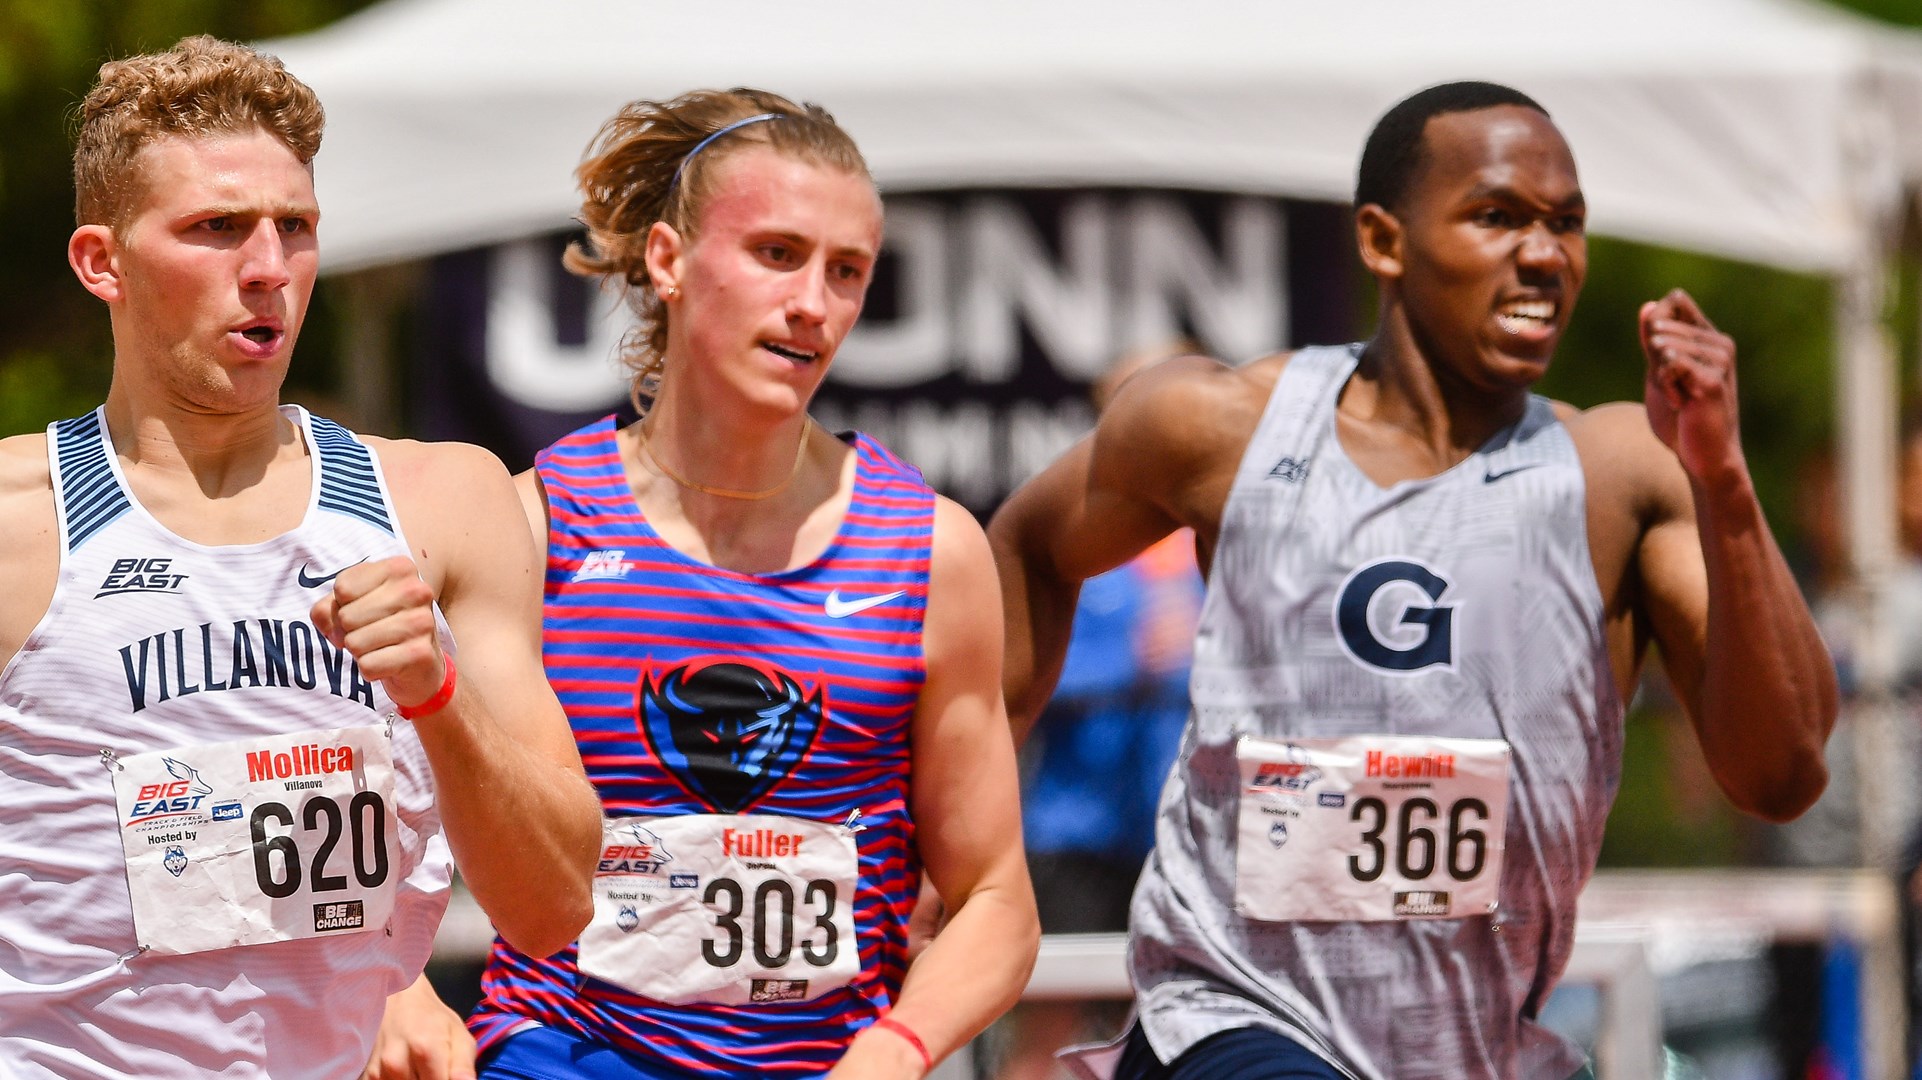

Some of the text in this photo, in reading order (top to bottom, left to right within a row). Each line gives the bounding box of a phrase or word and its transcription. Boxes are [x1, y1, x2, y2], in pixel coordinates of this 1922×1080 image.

[110, 558, 173, 573] BIG
[100, 575, 190, 589] EAST
[1336, 560, 1453, 671] G
[118, 619, 376, 713] VILLANOVA
[246, 744, 353, 782] Mollica
[1366, 750, 1456, 778] Hewitt
[137, 780, 190, 801] BIG
[284, 780, 323, 792] Villanova
[130, 795, 206, 817] EAST
[213, 806, 241, 818] Jeep
[147, 831, 198, 845] Hosted by
[250, 791, 389, 898] 620
[722, 828, 803, 857] Fuller
[1348, 797, 1490, 881] 366
[603, 846, 652, 860] BIG
[598, 861, 664, 874] EAST
[316, 916, 362, 929] CHANGE
[701, 878, 838, 967] 303
